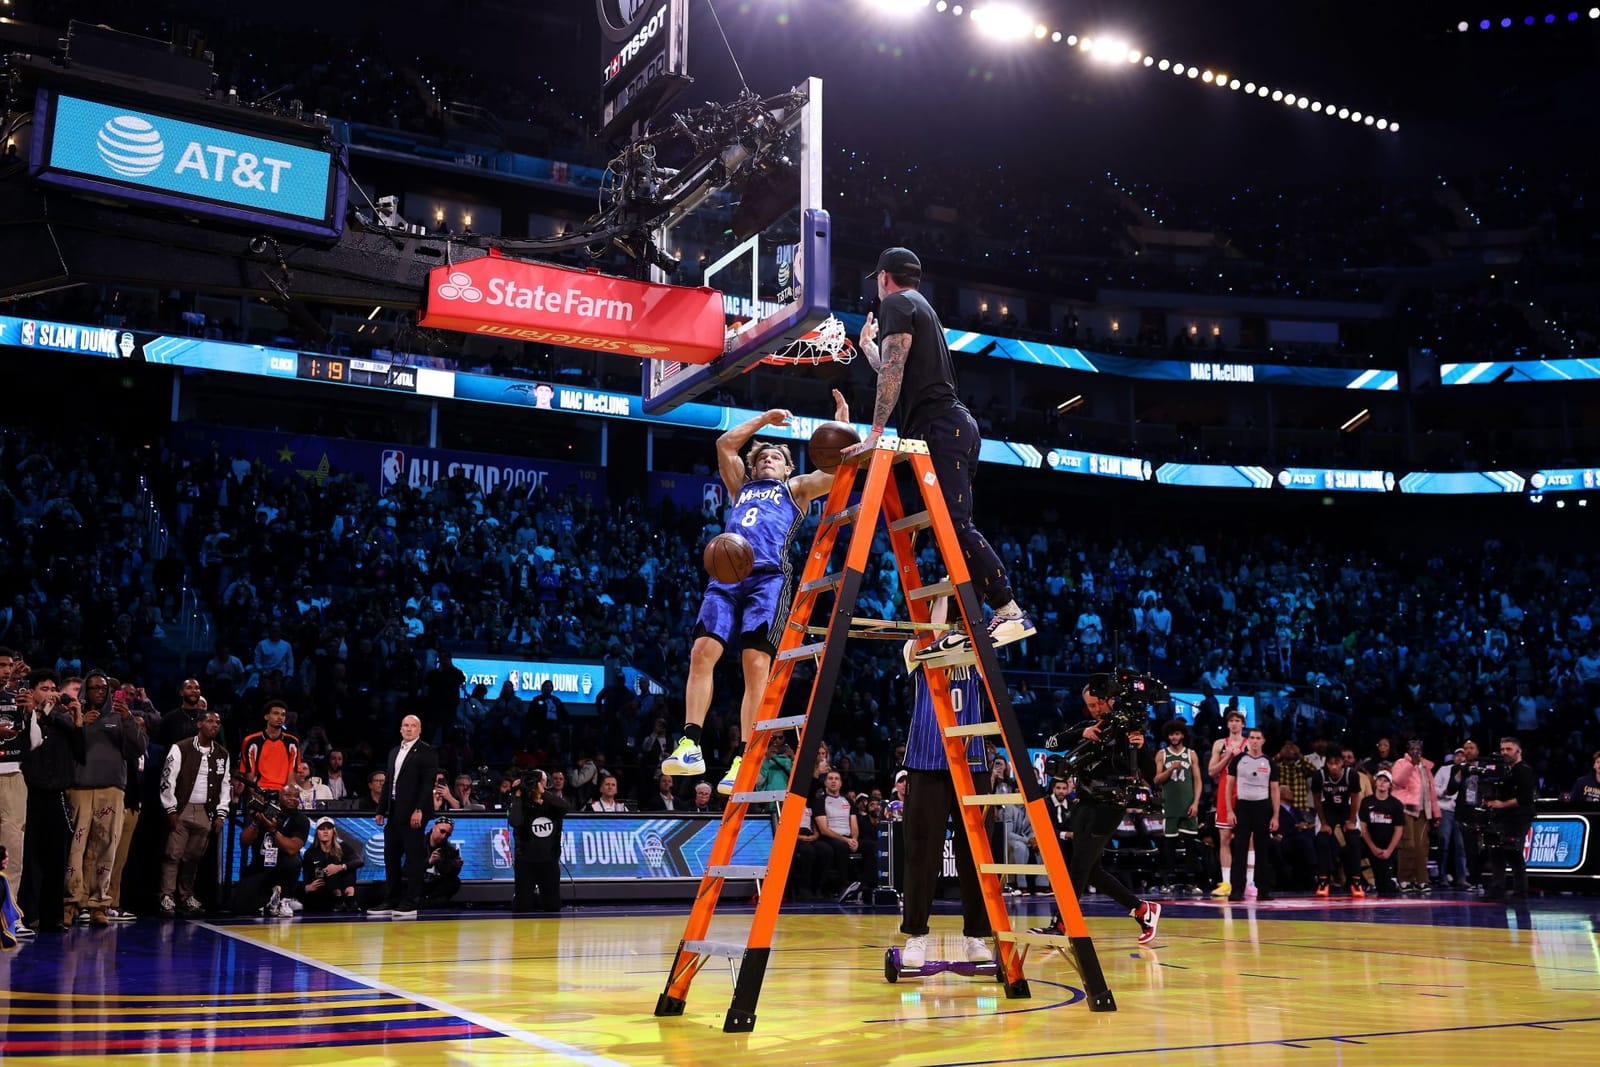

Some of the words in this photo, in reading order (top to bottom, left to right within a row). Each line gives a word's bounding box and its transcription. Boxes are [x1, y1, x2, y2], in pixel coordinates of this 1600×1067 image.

[620, 4, 667, 67] TISSOT
[174, 142, 291, 193] AT&T
[39, 324, 77, 349] SLAM
[80, 328, 119, 355] DUNK
[311, 359, 343, 380] 1:19
[393, 371, 415, 387] TOTAL
[1190, 363, 1211, 380] MAC
[1212, 364, 1254, 382] McCLUNG
[560, 390, 583, 410] MAC
[584, 393, 629, 416] McCLUNG
[1060, 455, 1081, 467] AT&T
[1099, 456, 1121, 475] SLAM
[1293, 474, 1316, 484] AT&T
[1335, 471, 1359, 488] SLAM
[1547, 474, 1574, 486] AT&T
[735, 485, 783, 508] Magic
[741, 507, 759, 527] 8
[469, 674, 498, 686] AT&T
[552, 673, 579, 692] DUNK
[1170, 769, 1186, 782] 44
[533, 821, 553, 833] TNT
[582, 831, 639, 865] DUNK
[1533, 833, 1559, 848] SLAM
[1531, 847, 1556, 863] DUNK
